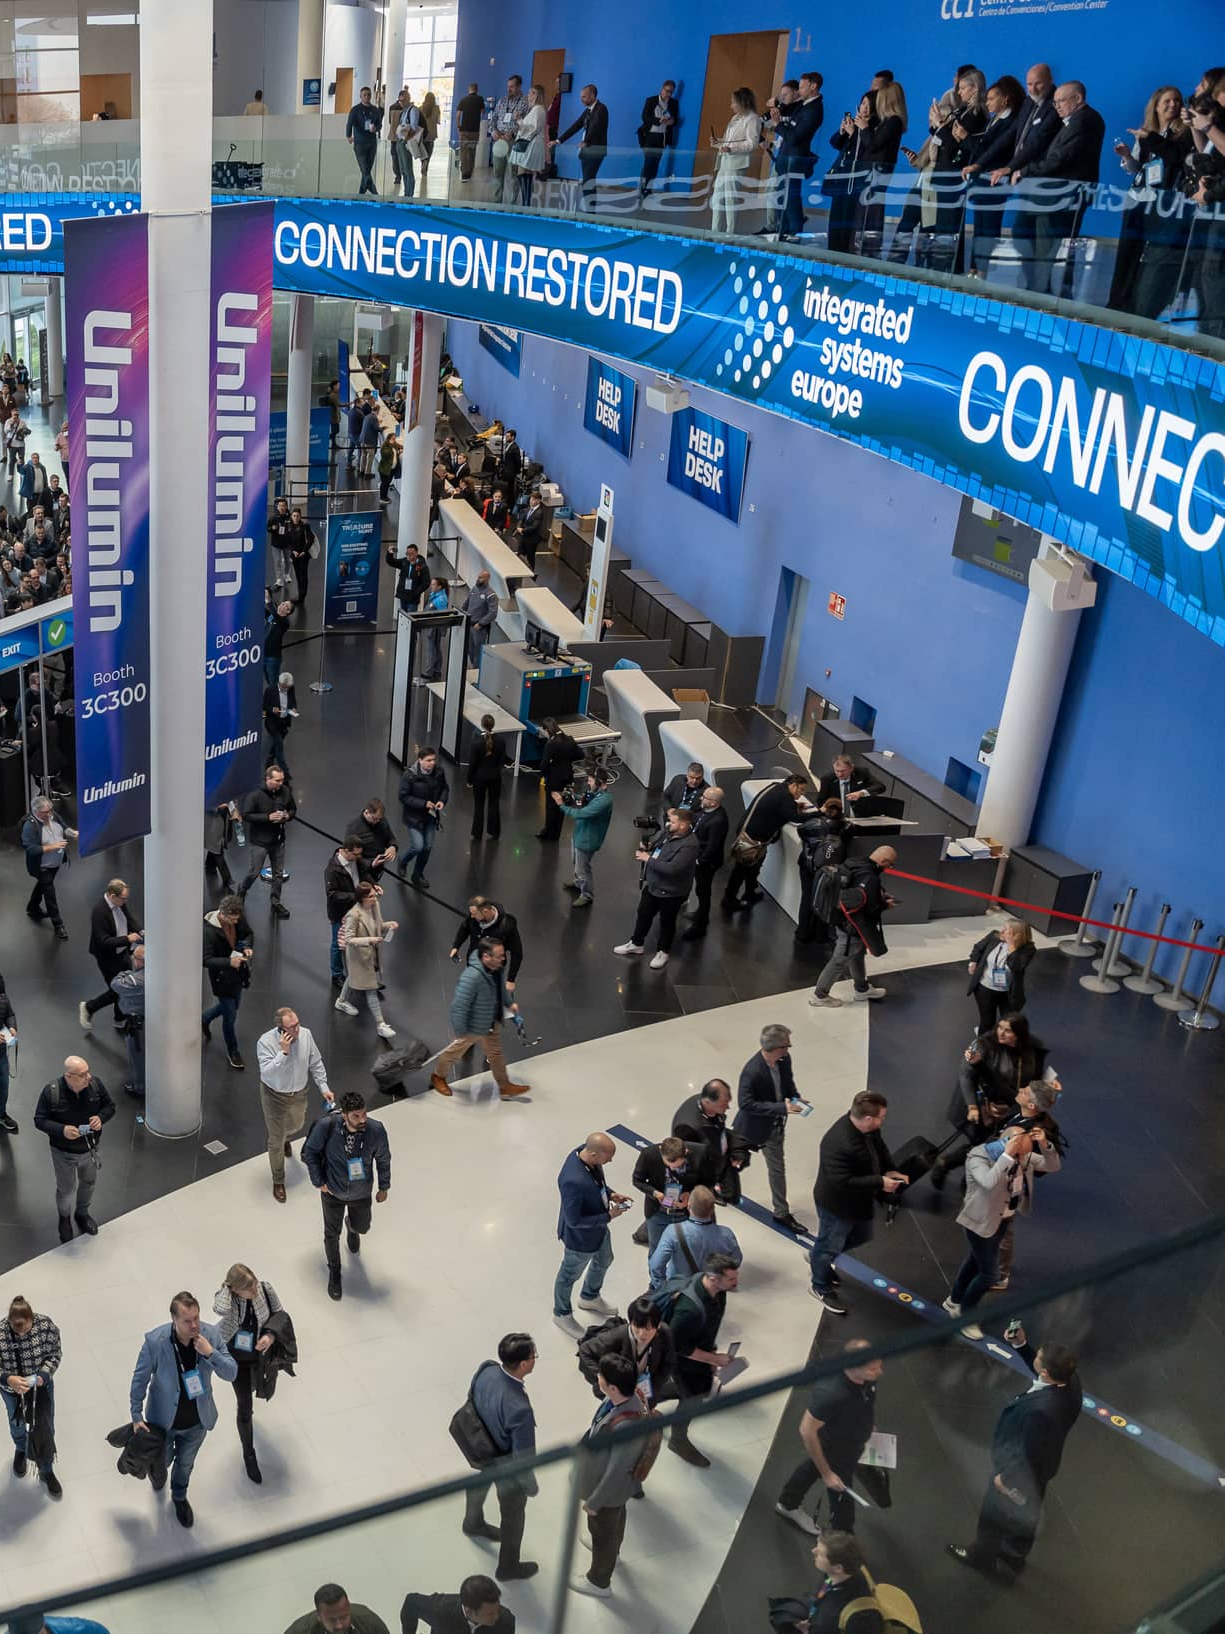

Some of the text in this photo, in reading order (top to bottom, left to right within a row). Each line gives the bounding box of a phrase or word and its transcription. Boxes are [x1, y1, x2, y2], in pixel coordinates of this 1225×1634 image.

[274, 219, 683, 335] CONNECTION RESTORED
[803, 277, 914, 345] integrated
[819, 336, 904, 390] systems
[598, 376, 622, 406] HELP
[791, 369, 863, 420] europe
[595, 399, 621, 435] DESK
[214, 291, 259, 598] Unilumin
[688, 424, 725, 463] HELP
[958, 350, 1225, 553] CONNEC
[83, 309, 135, 633] Unilumin
[684, 451, 724, 495] DESK
[2, 642, 22, 659] EXIT
[215, 626, 252, 650] Booth
[93, 663, 136, 688] Booth
[205, 644, 262, 680] 3C300
[81, 682, 147, 720] 3C300
[205, 729, 258, 761] Unilumin
[83, 771, 146, 805] Unilumin
